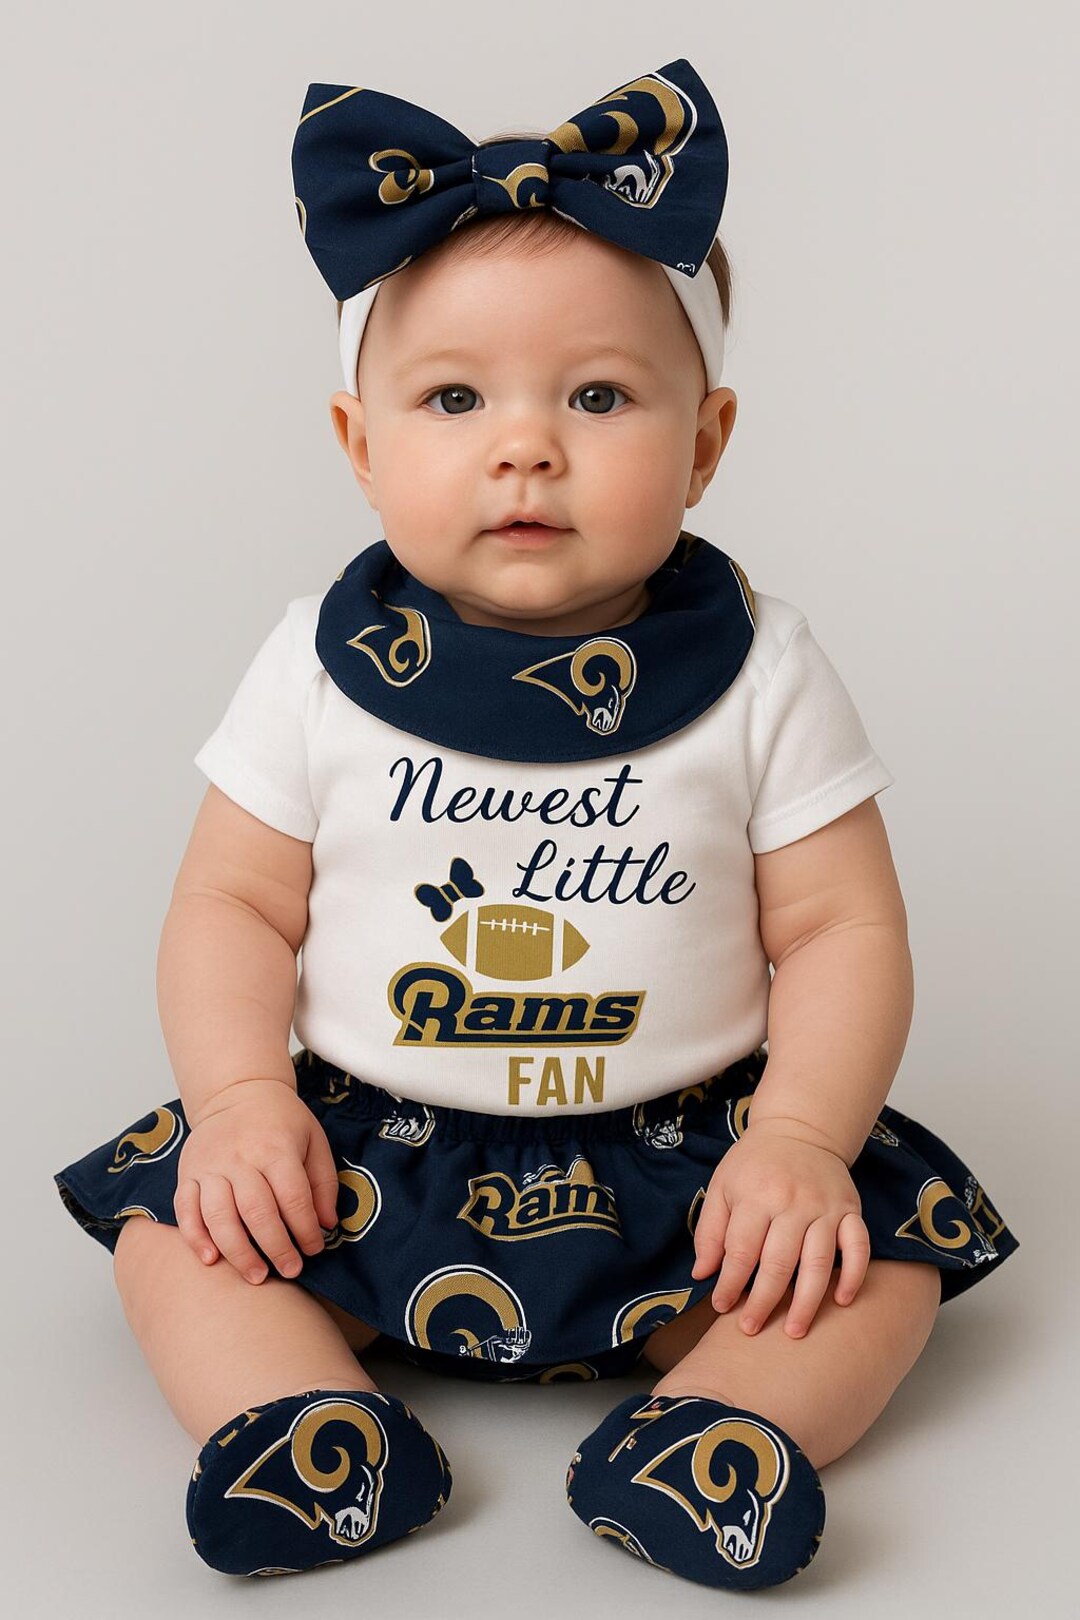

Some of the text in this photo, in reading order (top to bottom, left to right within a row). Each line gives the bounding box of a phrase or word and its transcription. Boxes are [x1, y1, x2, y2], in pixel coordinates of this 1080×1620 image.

[389, 757, 643, 828] Newest
[512, 839, 697, 905] Little
[390, 963, 645, 1046] Rams
[508, 1056, 605, 1105] FAN
